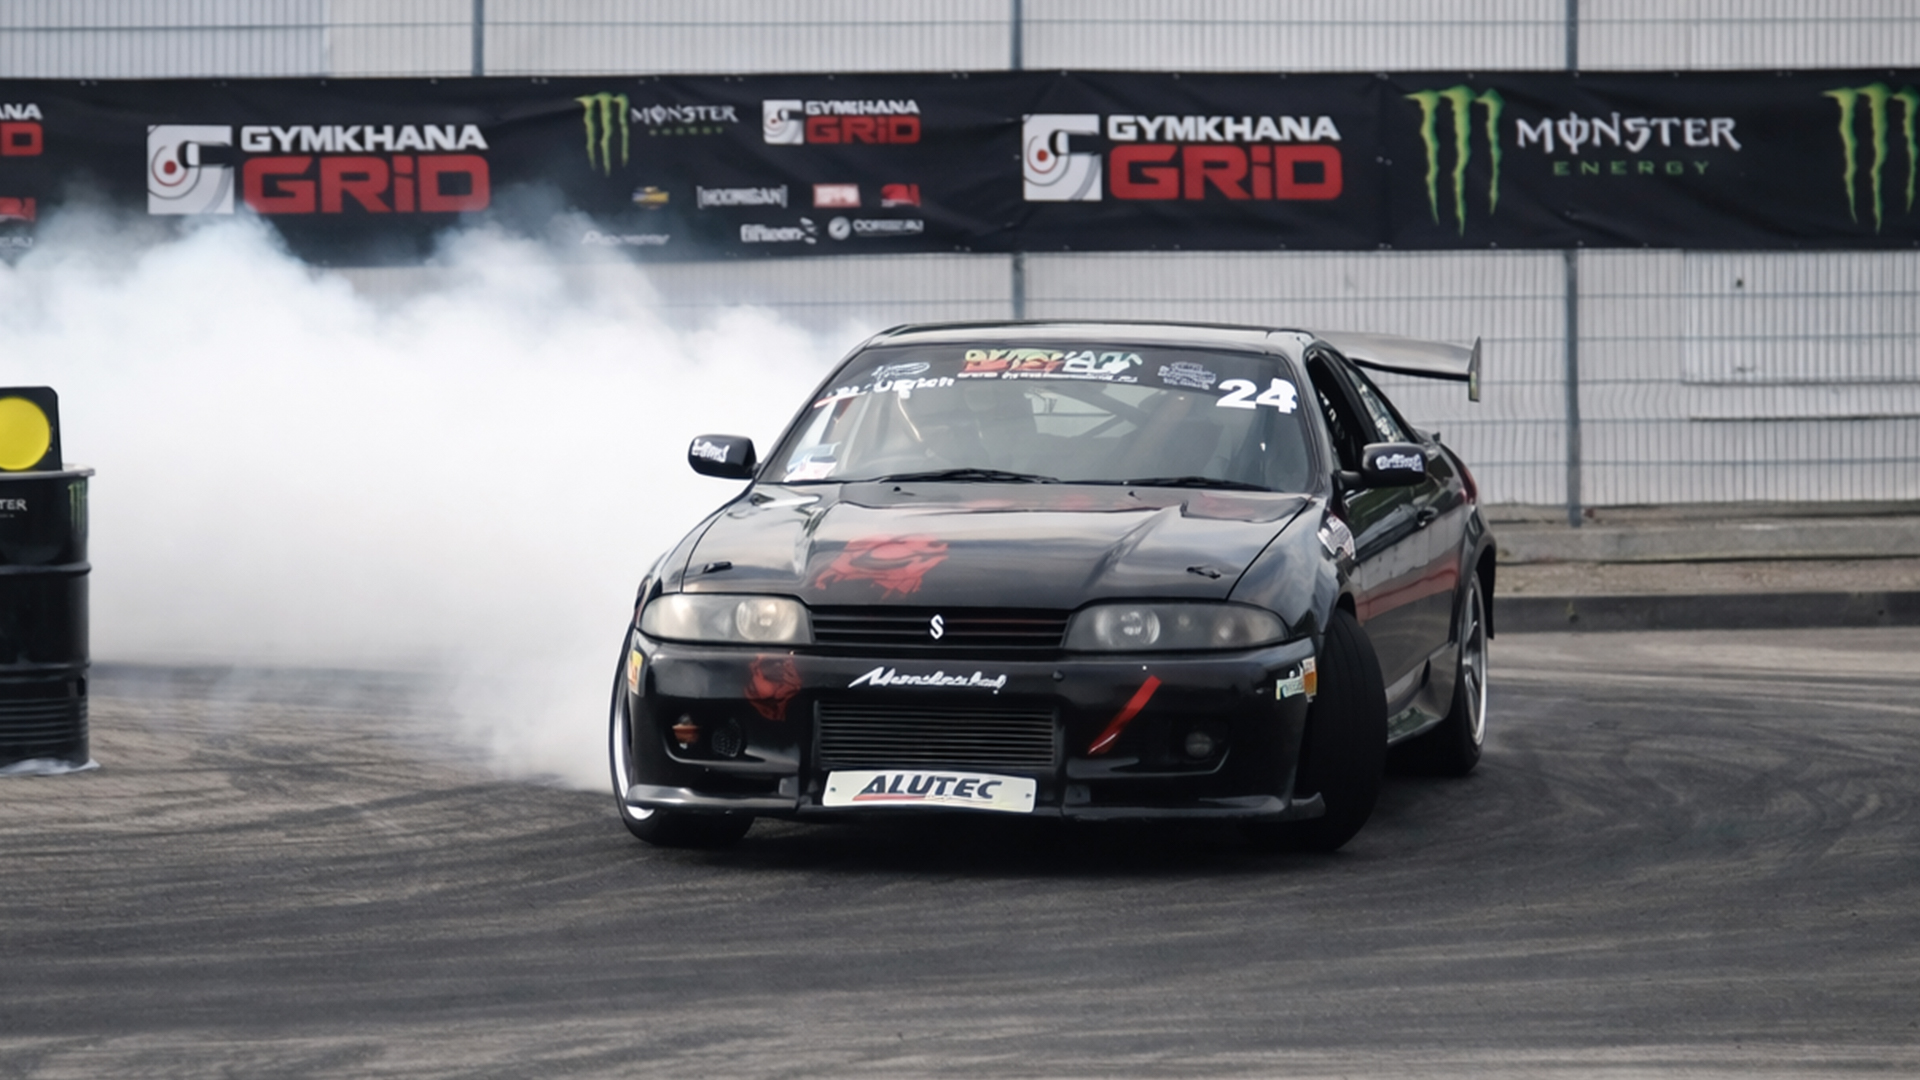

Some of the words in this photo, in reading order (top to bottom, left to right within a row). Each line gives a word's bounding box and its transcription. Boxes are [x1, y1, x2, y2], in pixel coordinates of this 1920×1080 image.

[631, 104, 739, 125] MONSTER
[806, 100, 920, 115] GYMKHANA
[241, 125, 488, 152] GYMKHANA
[1107, 115, 1341, 141] GYMKHANA
[1516, 112, 1742, 153] MONSTER
[1553, 160, 1711, 176] ENERGY
[1216, 377, 1298, 414] 24
[860, 774, 1003, 799] ALUTEC
